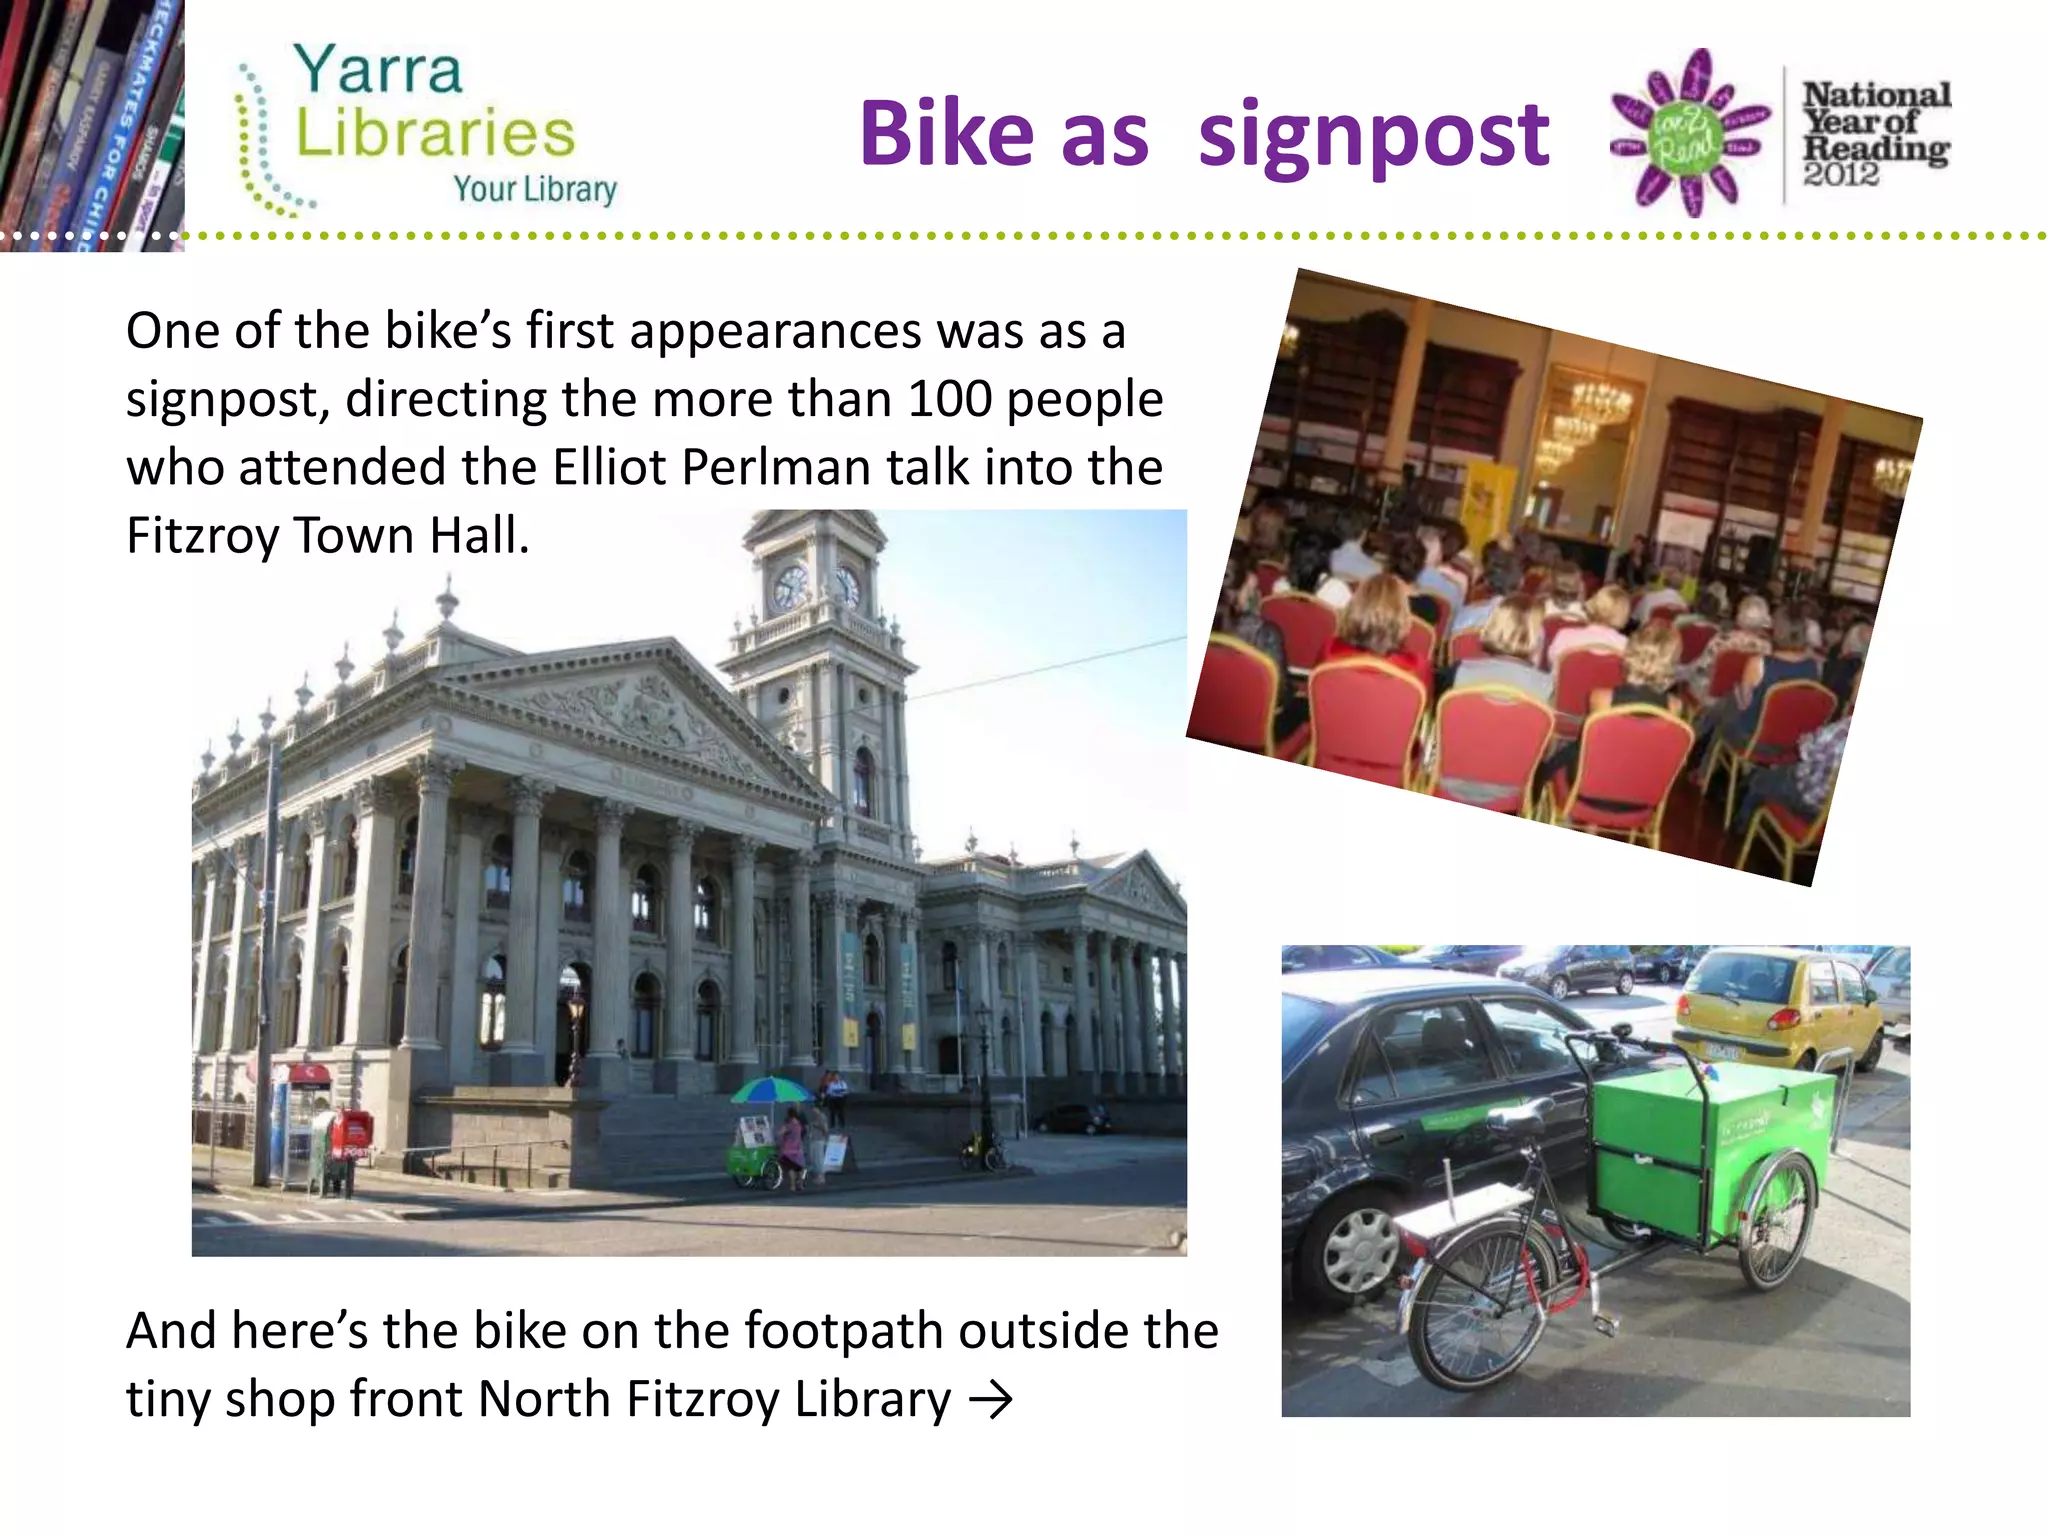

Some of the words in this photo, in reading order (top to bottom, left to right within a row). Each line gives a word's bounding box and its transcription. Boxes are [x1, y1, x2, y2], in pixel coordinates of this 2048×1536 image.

[292, 43, 463, 93] Yarra
[1803, 80, 1952, 108] National
[299, 106, 576, 156] Libraries
[1803, 108, 1881, 134] Year
[1884, 108, 1921, 134] of
[101, 133, 127, 181] FOR
[1803, 134, 1952, 168] Reading
[1804, 162, 1880, 186] 2012
[454, 175, 517, 202] Your
[524, 175, 618, 207] Library
